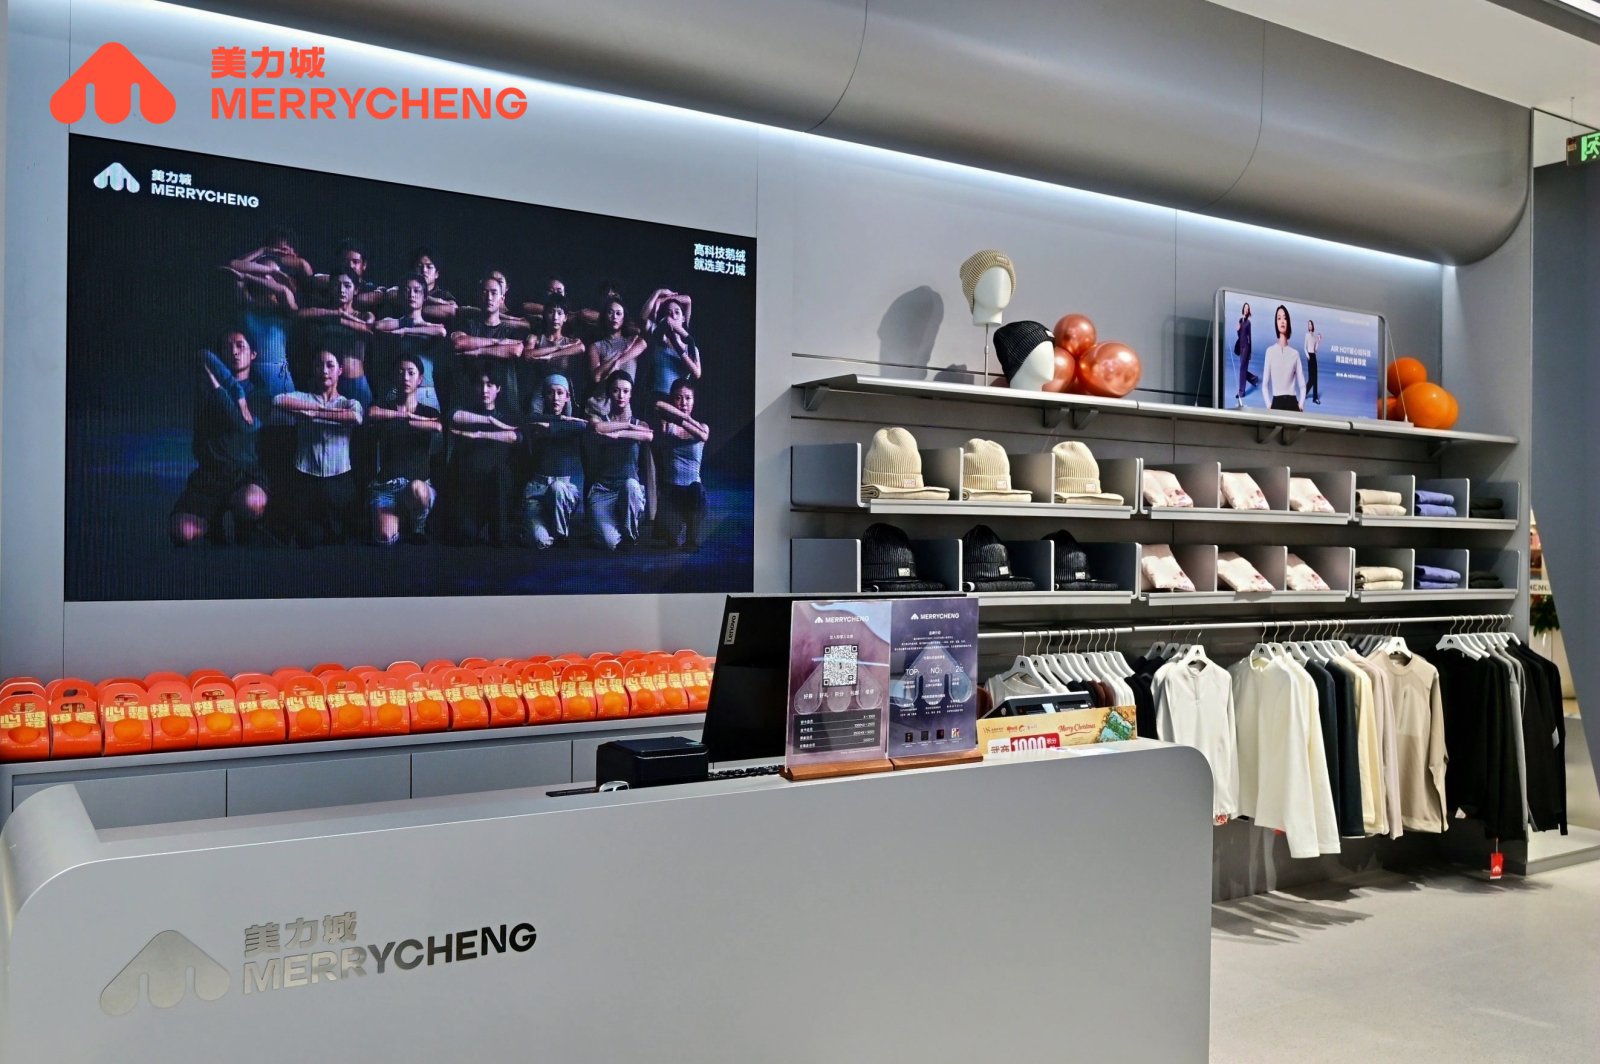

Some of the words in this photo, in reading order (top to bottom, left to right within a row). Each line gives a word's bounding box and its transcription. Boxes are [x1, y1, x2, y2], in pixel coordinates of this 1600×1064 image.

[151, 168, 192, 186] 美力城
[150, 182, 260, 208] MERRYCHENG
[693, 243, 747, 263] 高科技鹅绒
[693, 256, 747, 277] 就选美力城
[824, 615, 870, 624] MERRYCHENG
[920, 612, 960, 620] MERRYCHENG
[1058, 724, 1074, 732] Merry
[243, 911, 358, 958] 美力城
[242, 922, 538, 995] MERRYCHENG
